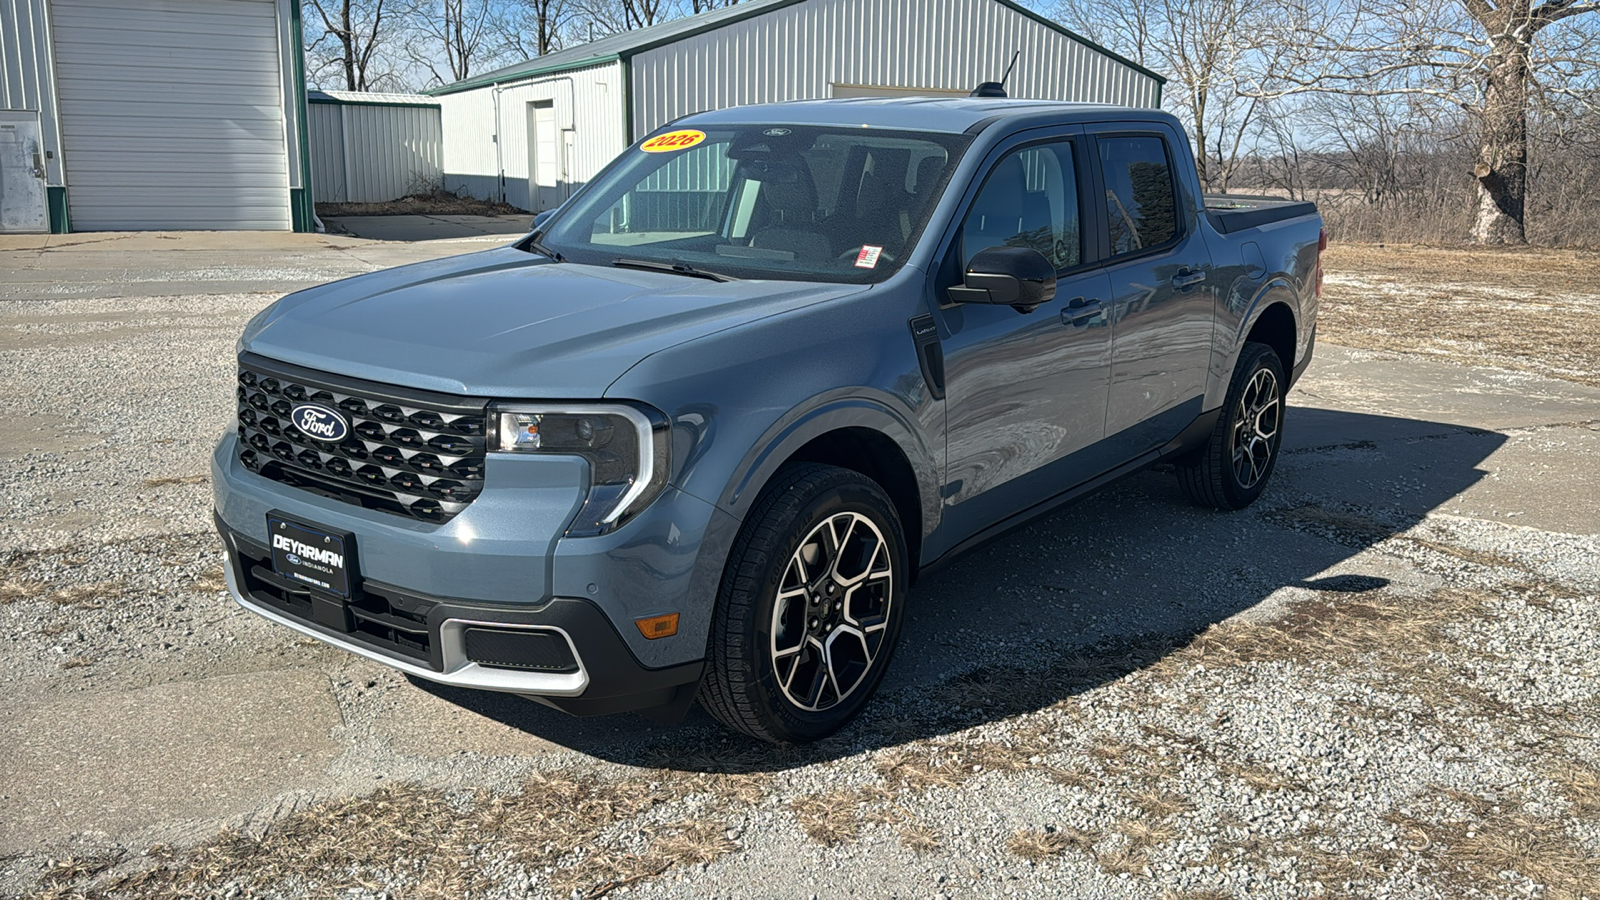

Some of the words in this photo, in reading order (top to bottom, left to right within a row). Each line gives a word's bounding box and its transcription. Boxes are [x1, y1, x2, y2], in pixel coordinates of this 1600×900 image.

[644, 134, 700, 148] 2026
[301, 409, 335, 437] Ford
[273, 533, 344, 569] DEYARMAN
[302, 560, 334, 575] INDIANOLA
